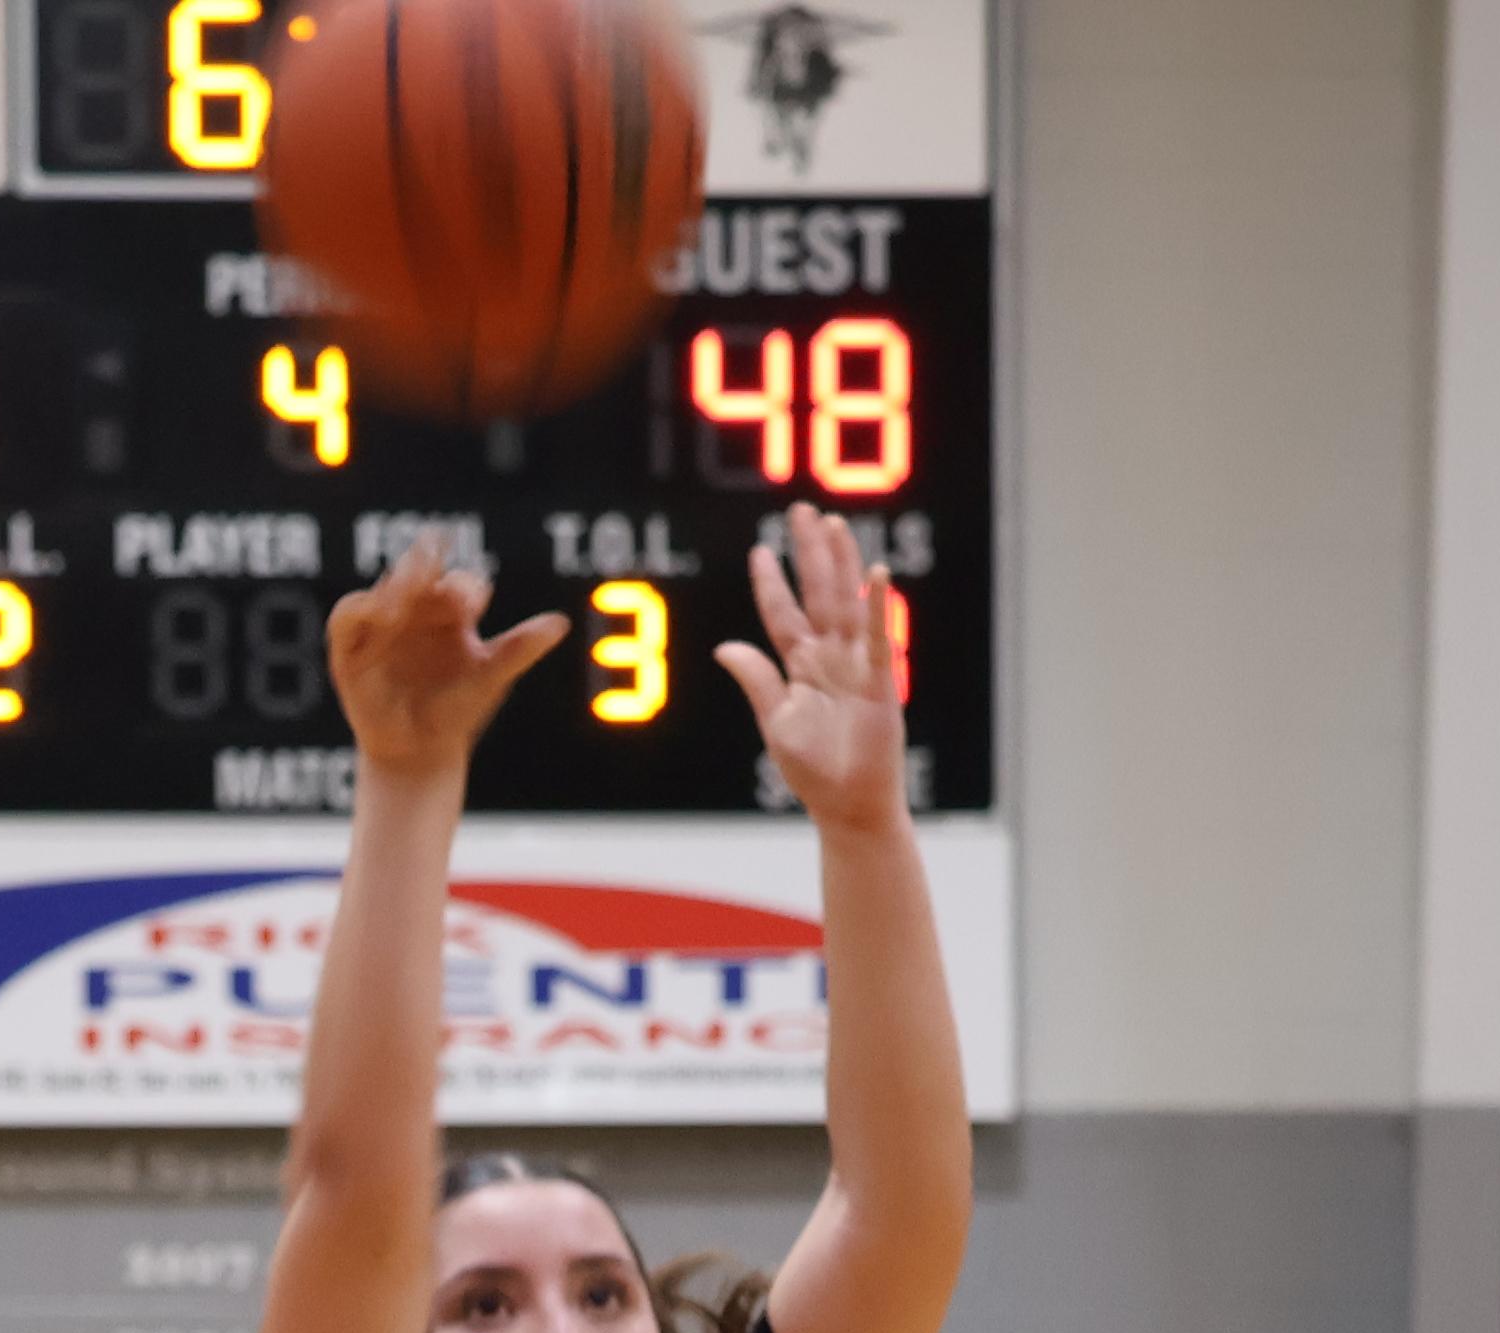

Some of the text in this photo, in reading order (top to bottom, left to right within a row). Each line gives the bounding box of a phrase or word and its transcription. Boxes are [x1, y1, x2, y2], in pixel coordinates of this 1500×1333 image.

[260, 343, 351, 470] 4
[690, 317, 912, 496] 48
[112, 512, 322, 579] PLAYER
[589, 579, 669, 723] 3
[213, 746, 358, 811] MATC
